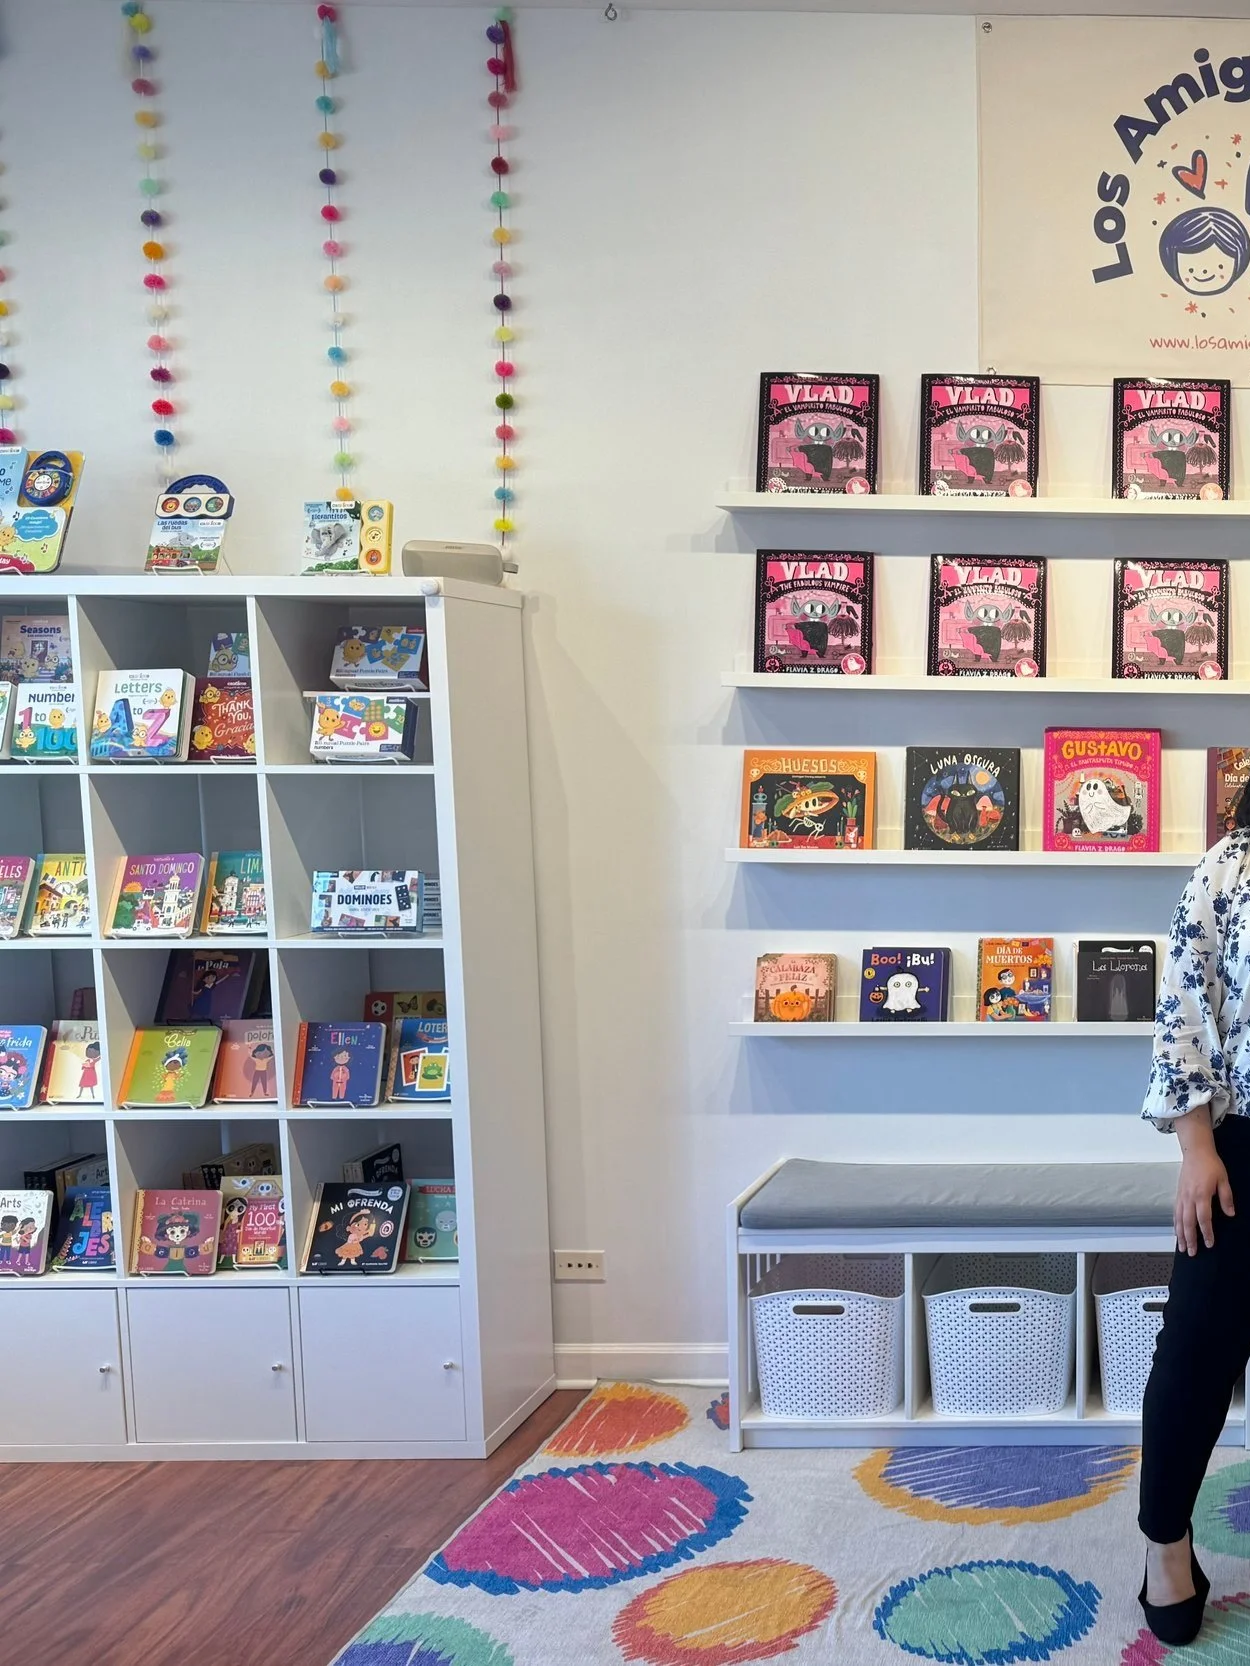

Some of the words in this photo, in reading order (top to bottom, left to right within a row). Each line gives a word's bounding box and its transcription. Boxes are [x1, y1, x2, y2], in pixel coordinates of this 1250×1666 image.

[1091, 171, 1134, 284] Los
[784, 384, 854, 405] VLAD
[946, 386, 1014, 407] VLAD
[1137, 390, 1206, 410] VLAD
[784, 405, 792, 413] EL
[793, 402, 824, 412] VAMPIRITO
[825, 402, 854, 415] FABULOSO
[954, 404, 985, 413] VAMPIRITO
[986, 405, 1015, 417] FABULOSO
[1146, 408, 1176, 417] VAMPIRITO
[1177, 408, 1206, 421] FABULOSO
[781, 561, 849, 581] VLAD
[954, 566, 1022, 587] VLAD
[779, 583, 788, 591] THE
[824, 580, 850, 592] VAMPIRE
[1137, 569, 1205, 590] VLAD
[20, 625, 61, 634] Seasons
[114, 681, 163, 694] Letters
[133, 707, 143, 716] to
[211, 699, 253, 716] THANK
[1061, 740, 1143, 761] GUSTAVO
[781, 757, 839, 773] HUESOS
[930, 755, 958, 775] LUNA
[963, 753, 1001, 778] OSCURA
[1224, 772, 1237, 783] Día
[130, 863, 156, 876] SANTO
[158, 861, 195, 875] DOMINGO
[337, 894, 393, 905] DOMINOES
[996, 946, 1012, 954] DÍA
[871, 953, 902, 966] Boo!
[906, 953, 935, 967] ¡Bu!
[986, 954, 1033, 964] MUERTOS
[1092, 960, 1106, 971] La
[1110, 960, 1148, 971] Llorona
[769, 963, 816, 974] CALABAZA
[776, 973, 807, 982] FELIZ
[7, 1036, 33, 1048] Frida
[164, 1033, 192, 1048] Celia
[155, 1197, 166, 1206] La
[171, 1197, 207, 1206] Catrina
[260, 1203, 276, 1211] First
[330, 1202, 344, 1214] MI
[347, 1198, 394, 1214] OFRENDA
[246, 1211, 277, 1227] 100
